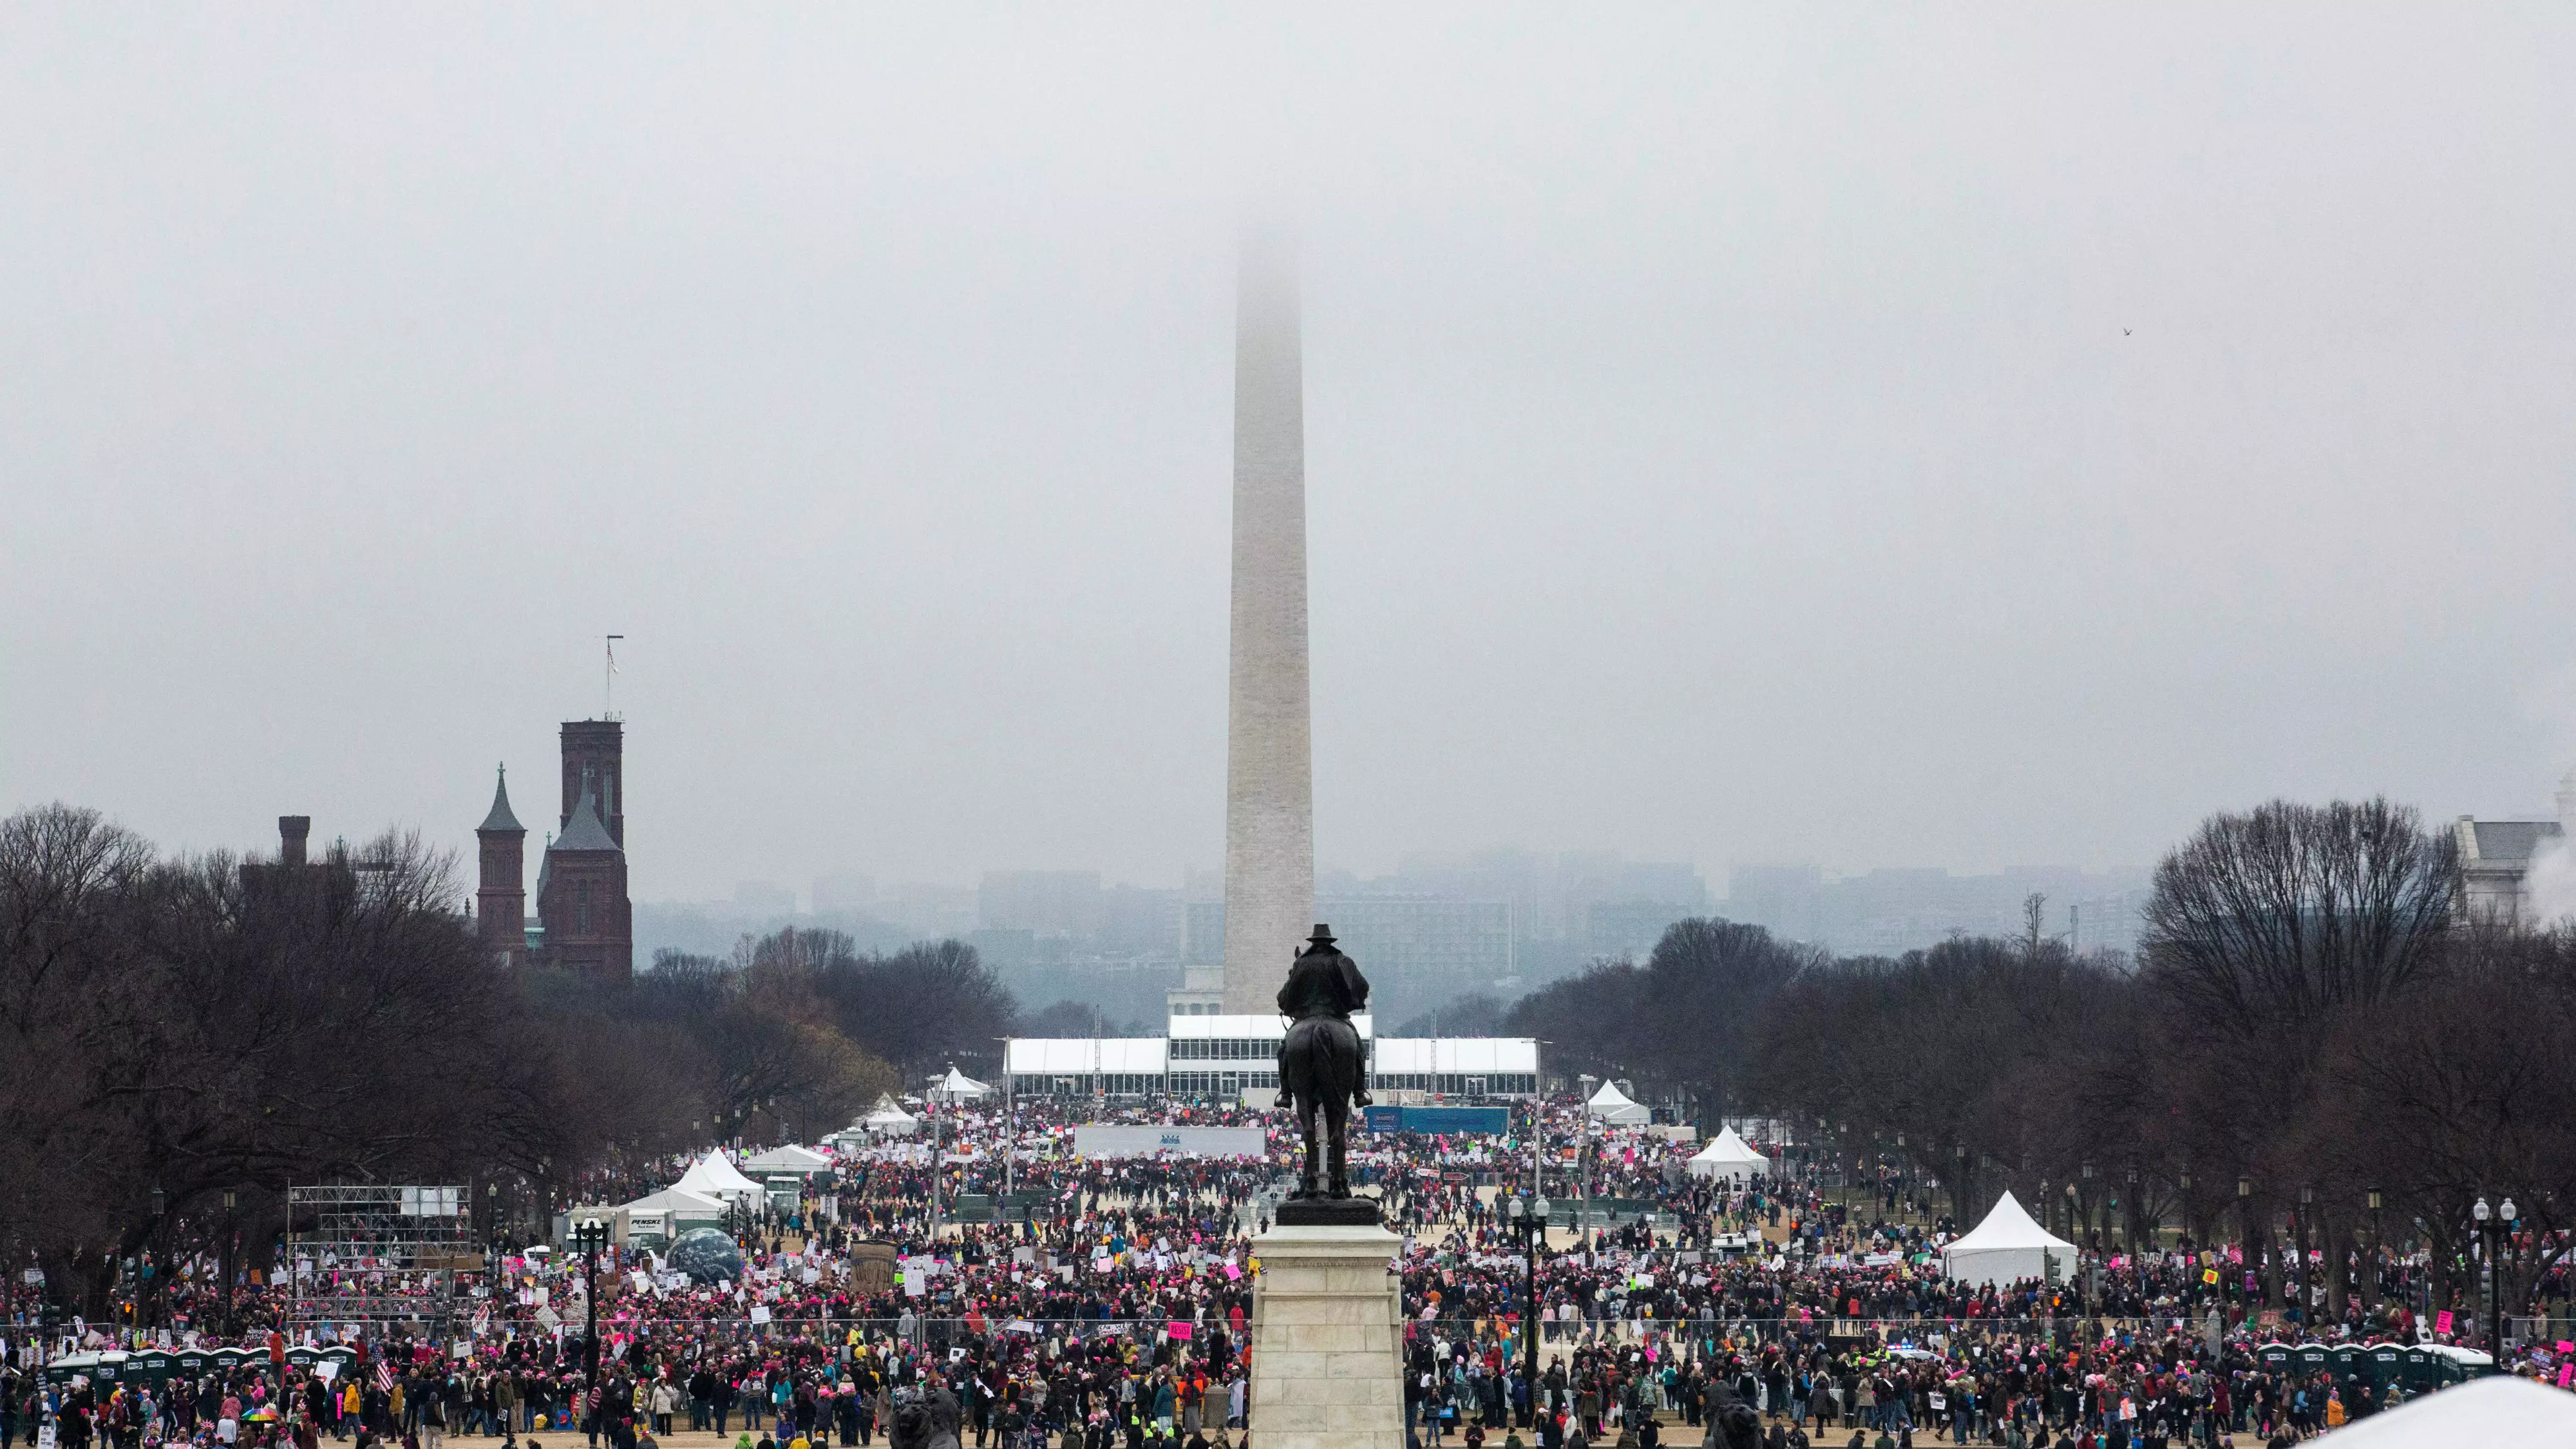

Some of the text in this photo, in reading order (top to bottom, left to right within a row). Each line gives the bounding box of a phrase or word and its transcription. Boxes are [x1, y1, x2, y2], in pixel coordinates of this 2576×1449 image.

[473, 1309, 488, 1330] TRUMP
[475, 1303, 488, 1320] DUMP
[1171, 1325, 1190, 1334] RESIST
